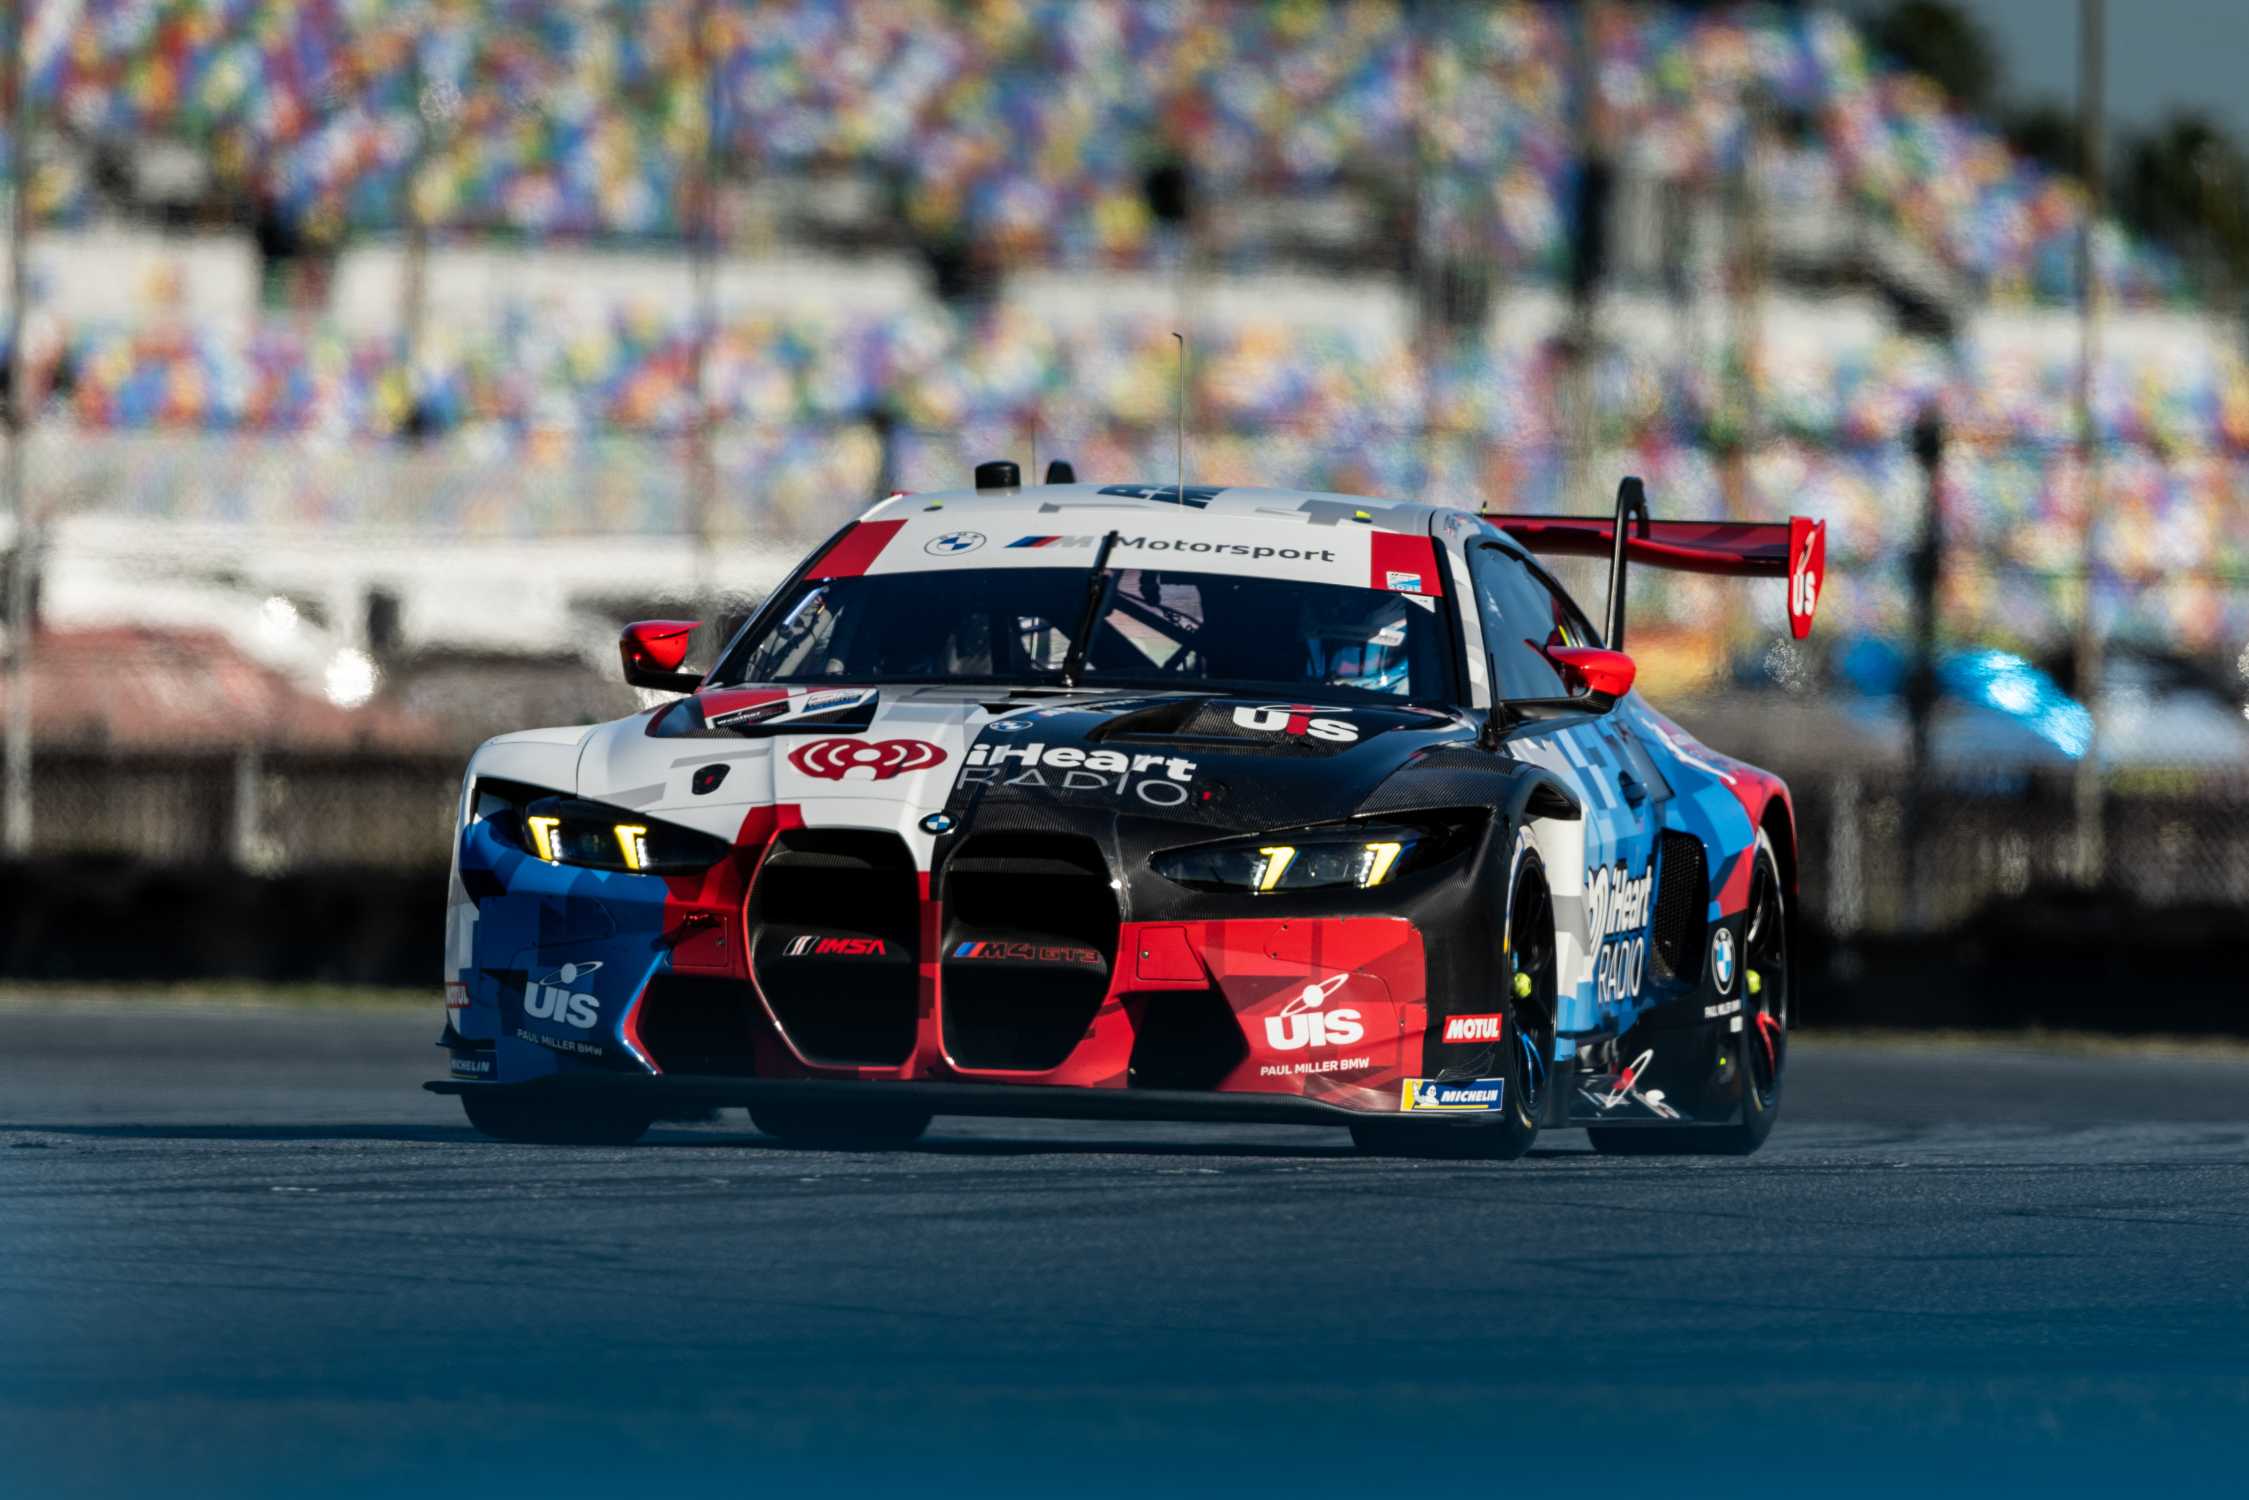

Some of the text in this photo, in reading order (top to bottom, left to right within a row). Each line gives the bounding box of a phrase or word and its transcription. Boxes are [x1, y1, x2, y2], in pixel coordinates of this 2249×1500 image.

[1116, 536, 1335, 562] Motorsport
[966, 743, 1197, 782] iHeart
[956, 767, 1189, 807] RADIO
[1604, 865, 1652, 935] iHeart
[815, 938, 887, 955] IMSA
[1598, 936, 1645, 1003] RADIO
[523, 981, 600, 1029] UIS
[516, 1028, 539, 1044] PAUL
[1264, 1009, 1365, 1050] UIS
[1446, 1018, 1499, 1040] MOTUL
[1260, 1057, 1370, 1076] PAUL MILLER BMW
[1441, 1089, 1499, 1103] MICHELIN
